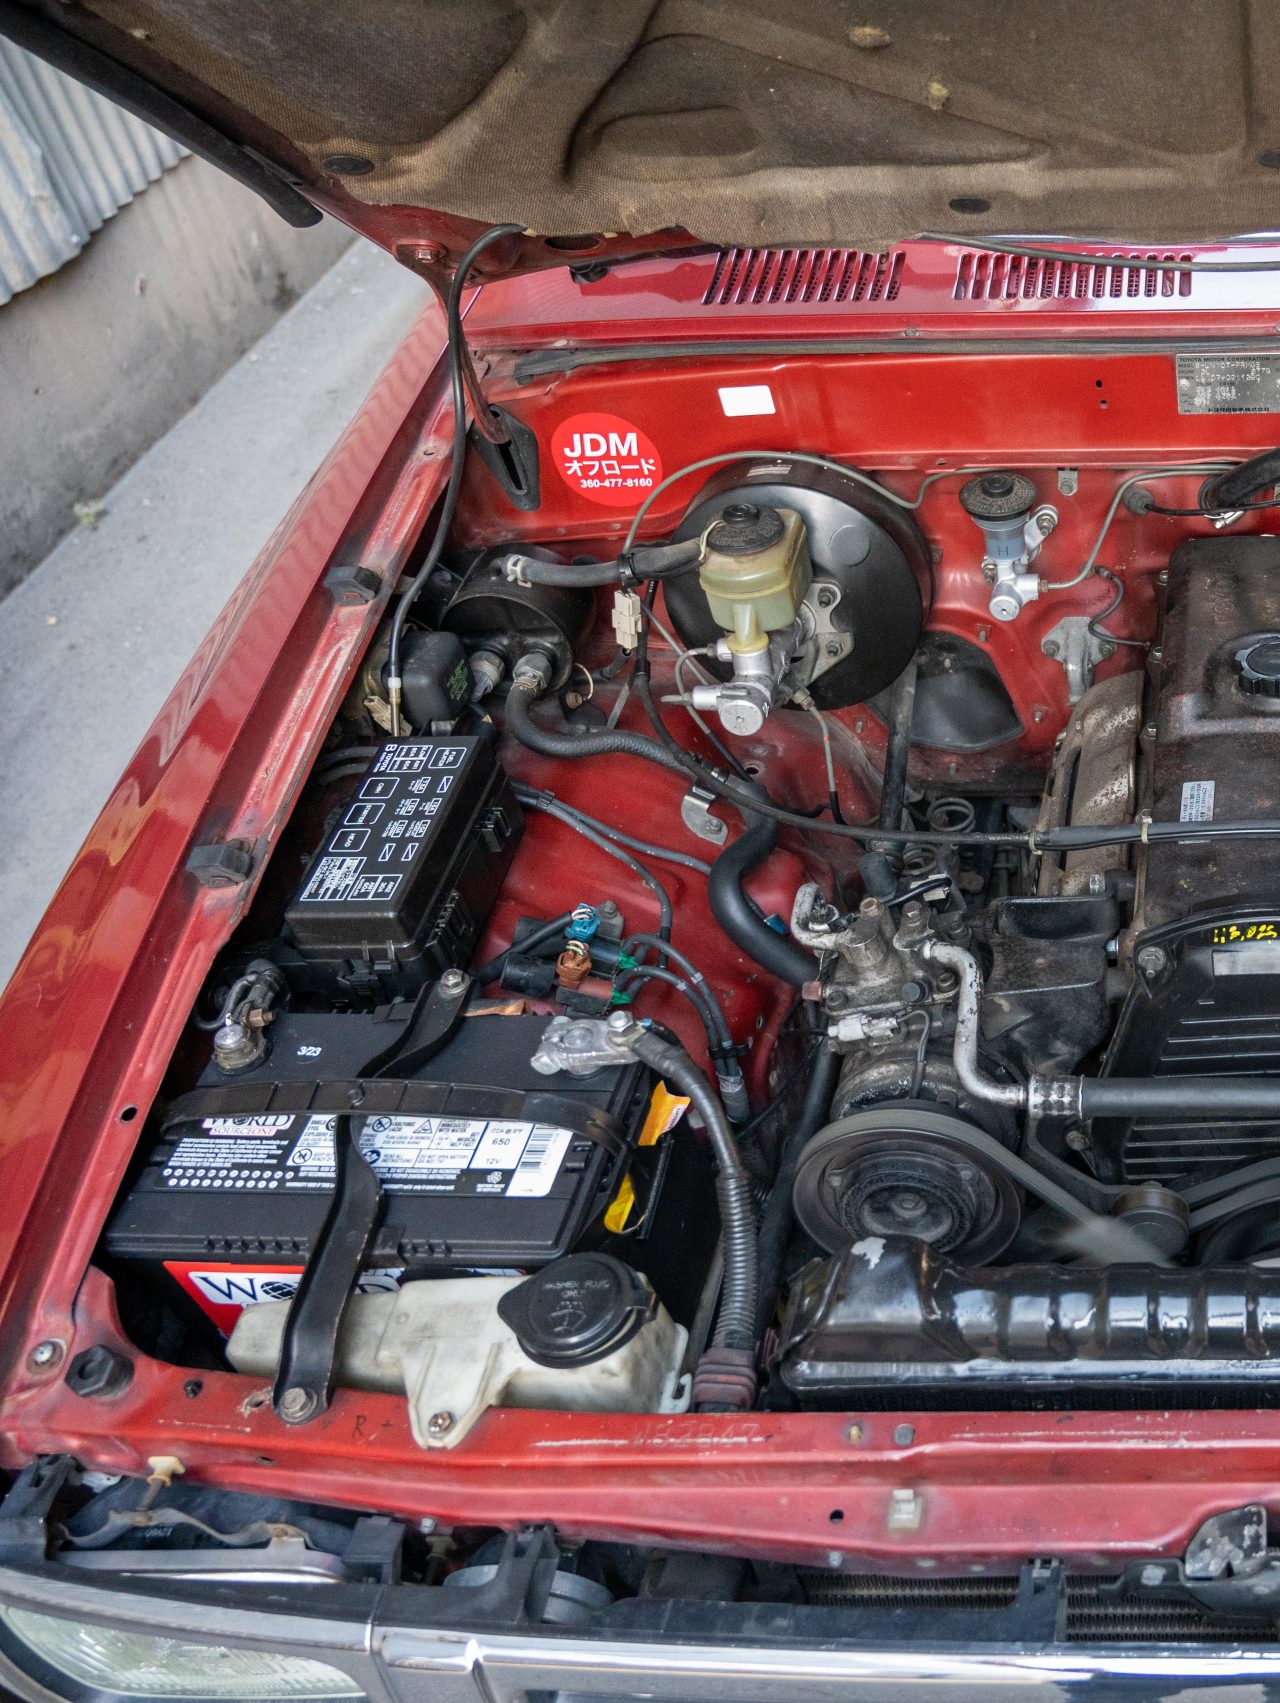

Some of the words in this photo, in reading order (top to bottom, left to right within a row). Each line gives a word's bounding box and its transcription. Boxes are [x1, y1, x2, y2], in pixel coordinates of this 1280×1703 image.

[563, 432, 638, 458] JDM
[564, 458, 656, 477] オフロード
[580, 478, 653, 489] 360-477-8160
[379, 752, 394, 772] TOYOTA
[445, 751, 457, 764] FUEL
[297, 1045, 322, 1057] 3/23
[212, 1126, 274, 1136] SOURCEONE
[491, 1137, 510, 1146] 650
[485, 1157, 502, 1165] 12V
[543, 1279, 579, 1290] WASHER
